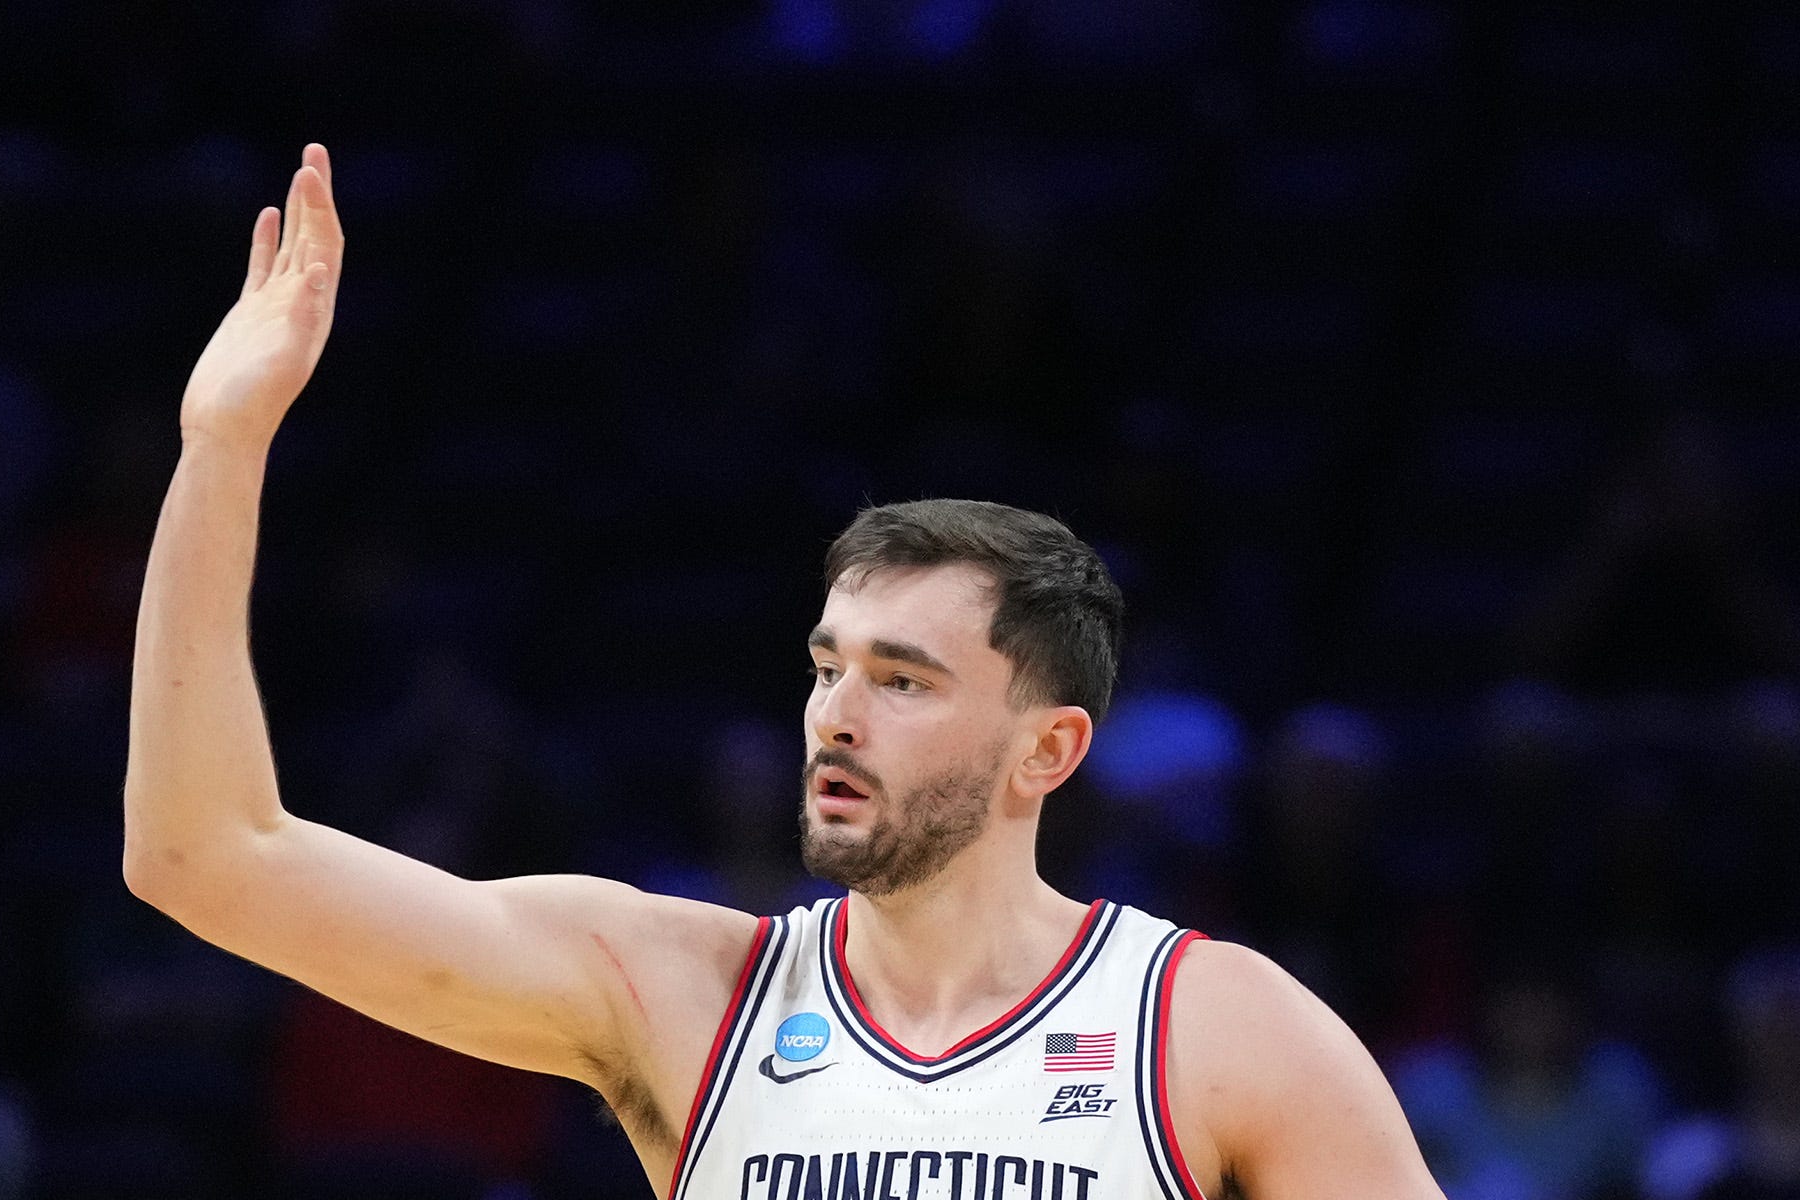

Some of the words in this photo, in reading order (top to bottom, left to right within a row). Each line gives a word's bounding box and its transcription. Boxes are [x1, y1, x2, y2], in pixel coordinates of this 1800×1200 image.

[780, 1035, 824, 1048] NCAA
[1053, 1084, 1107, 1099] BIG
[1045, 1099, 1118, 1114] EAST
